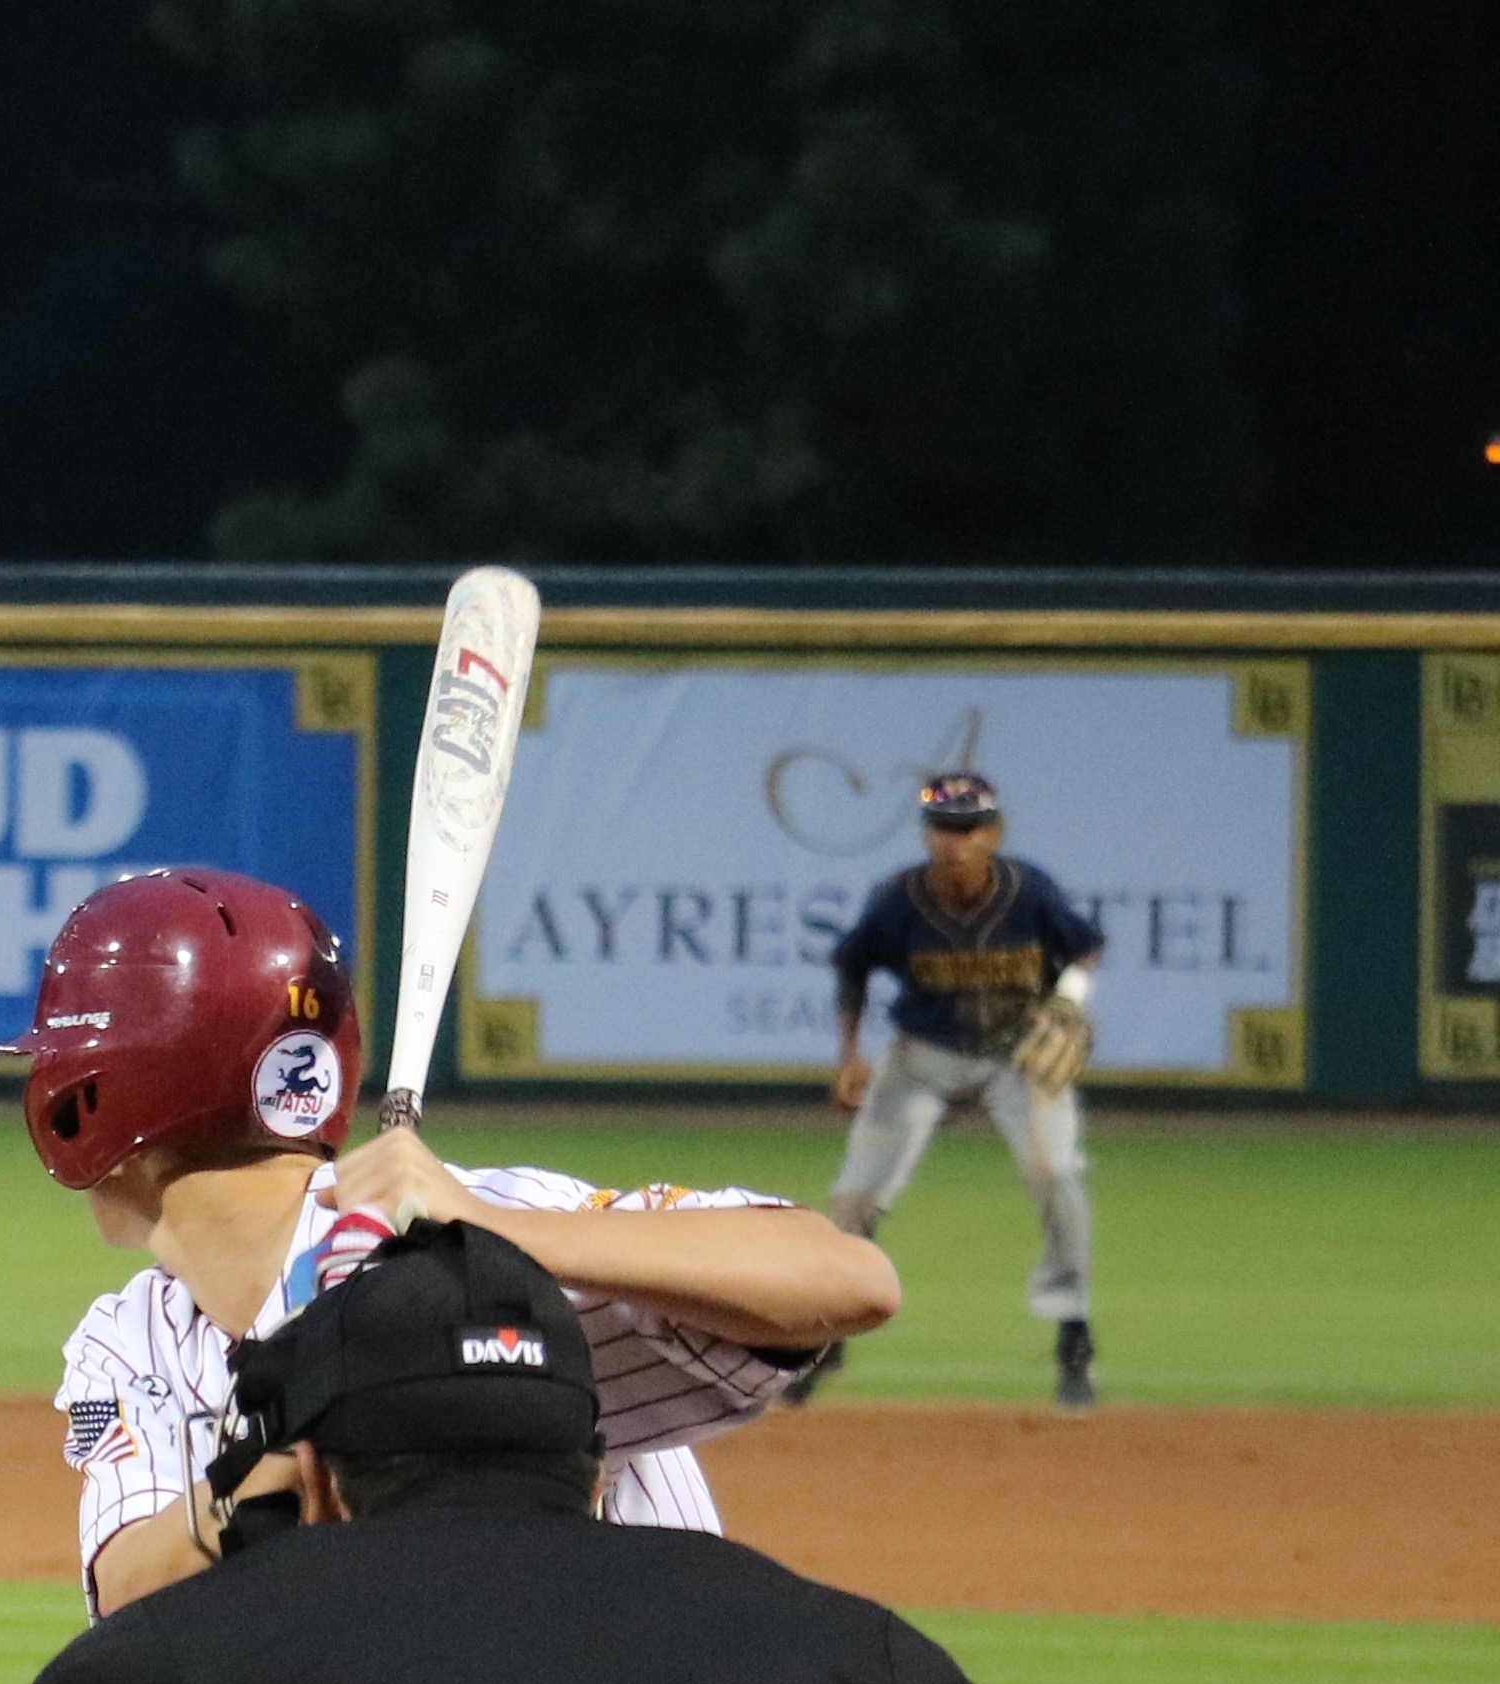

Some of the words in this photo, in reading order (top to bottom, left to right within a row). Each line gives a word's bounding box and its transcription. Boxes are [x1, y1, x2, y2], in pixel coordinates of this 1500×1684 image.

[504, 884, 850, 967] AYRES
[287, 985, 320, 1020] 16
[462, 1337, 545, 1367] DAVIS
